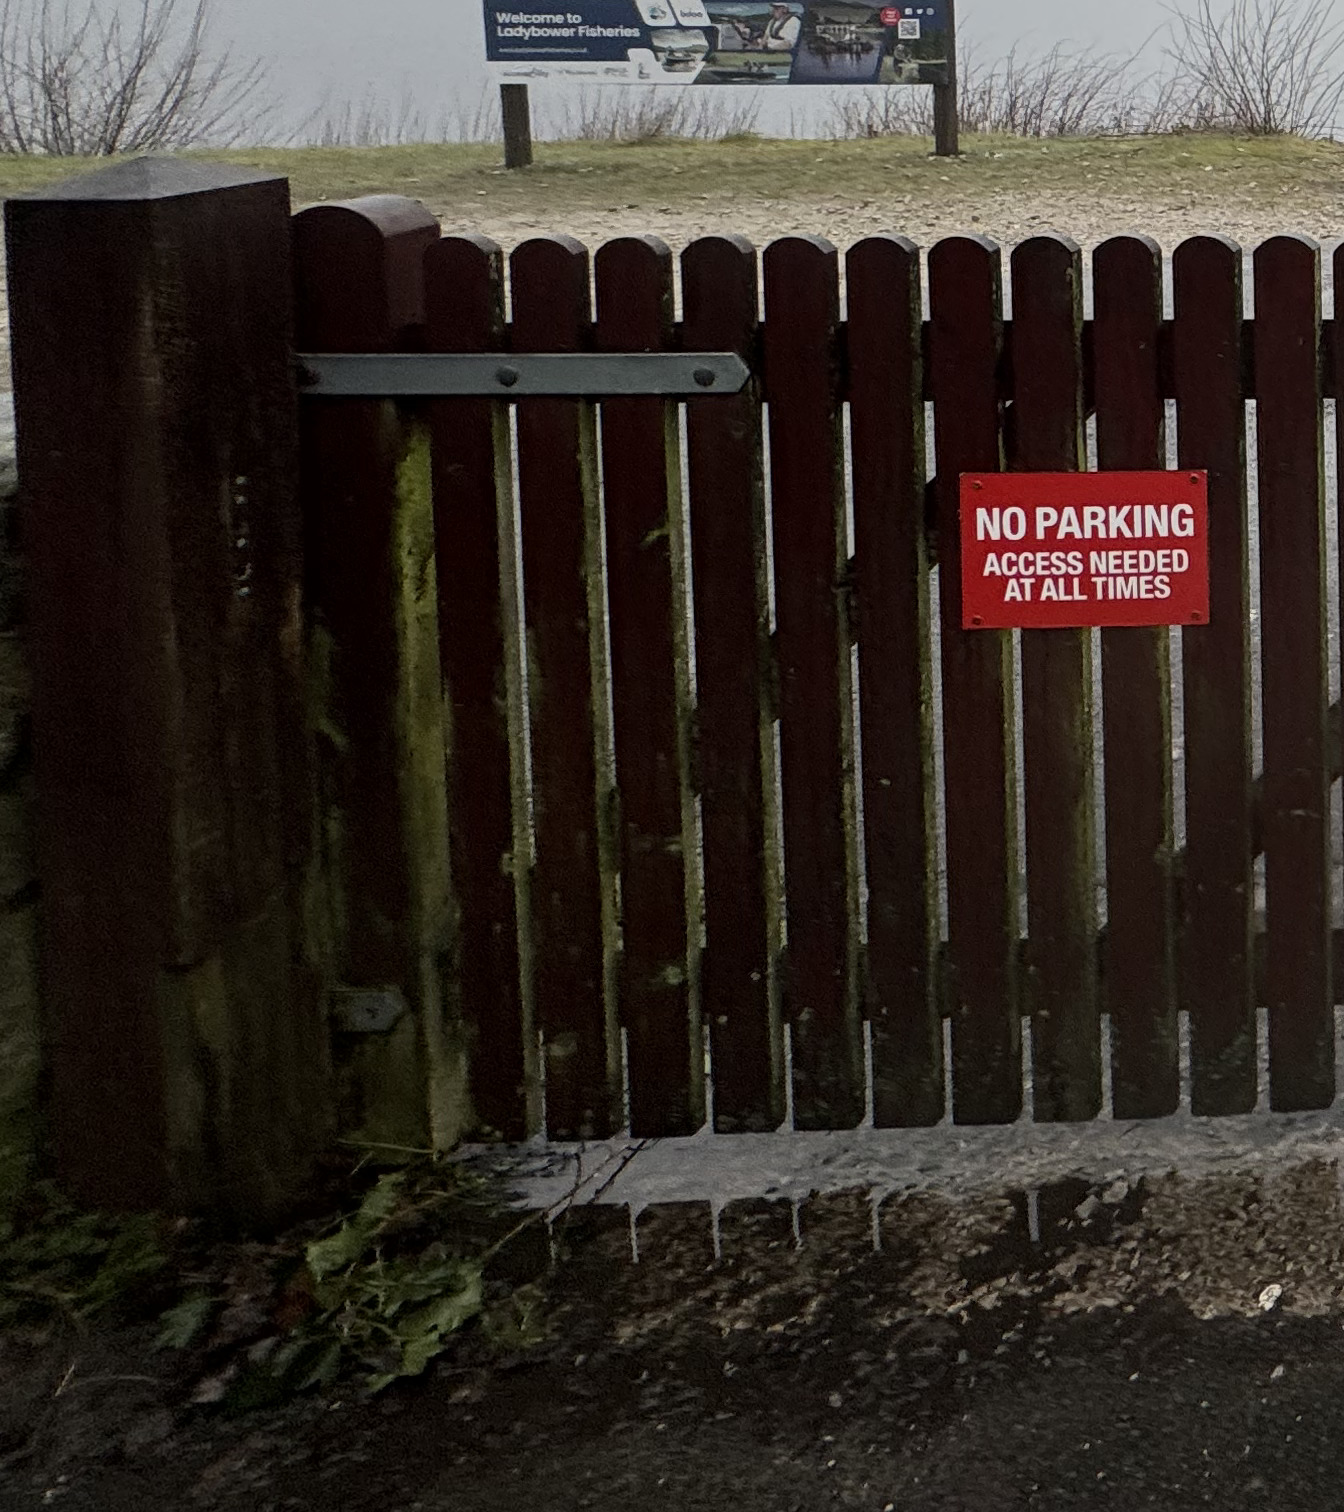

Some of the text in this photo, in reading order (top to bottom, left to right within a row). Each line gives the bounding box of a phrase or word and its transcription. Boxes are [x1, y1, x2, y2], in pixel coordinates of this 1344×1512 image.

[496, 12, 582, 24] Welcome to
[497, 25, 640, 40] Ladybower Fisheries
[976, 503, 1194, 541] NO PARKING
[983, 549, 1189, 576] ACCESS NEEDED
[1004, 575, 1171, 602] AT ALL TIMES
